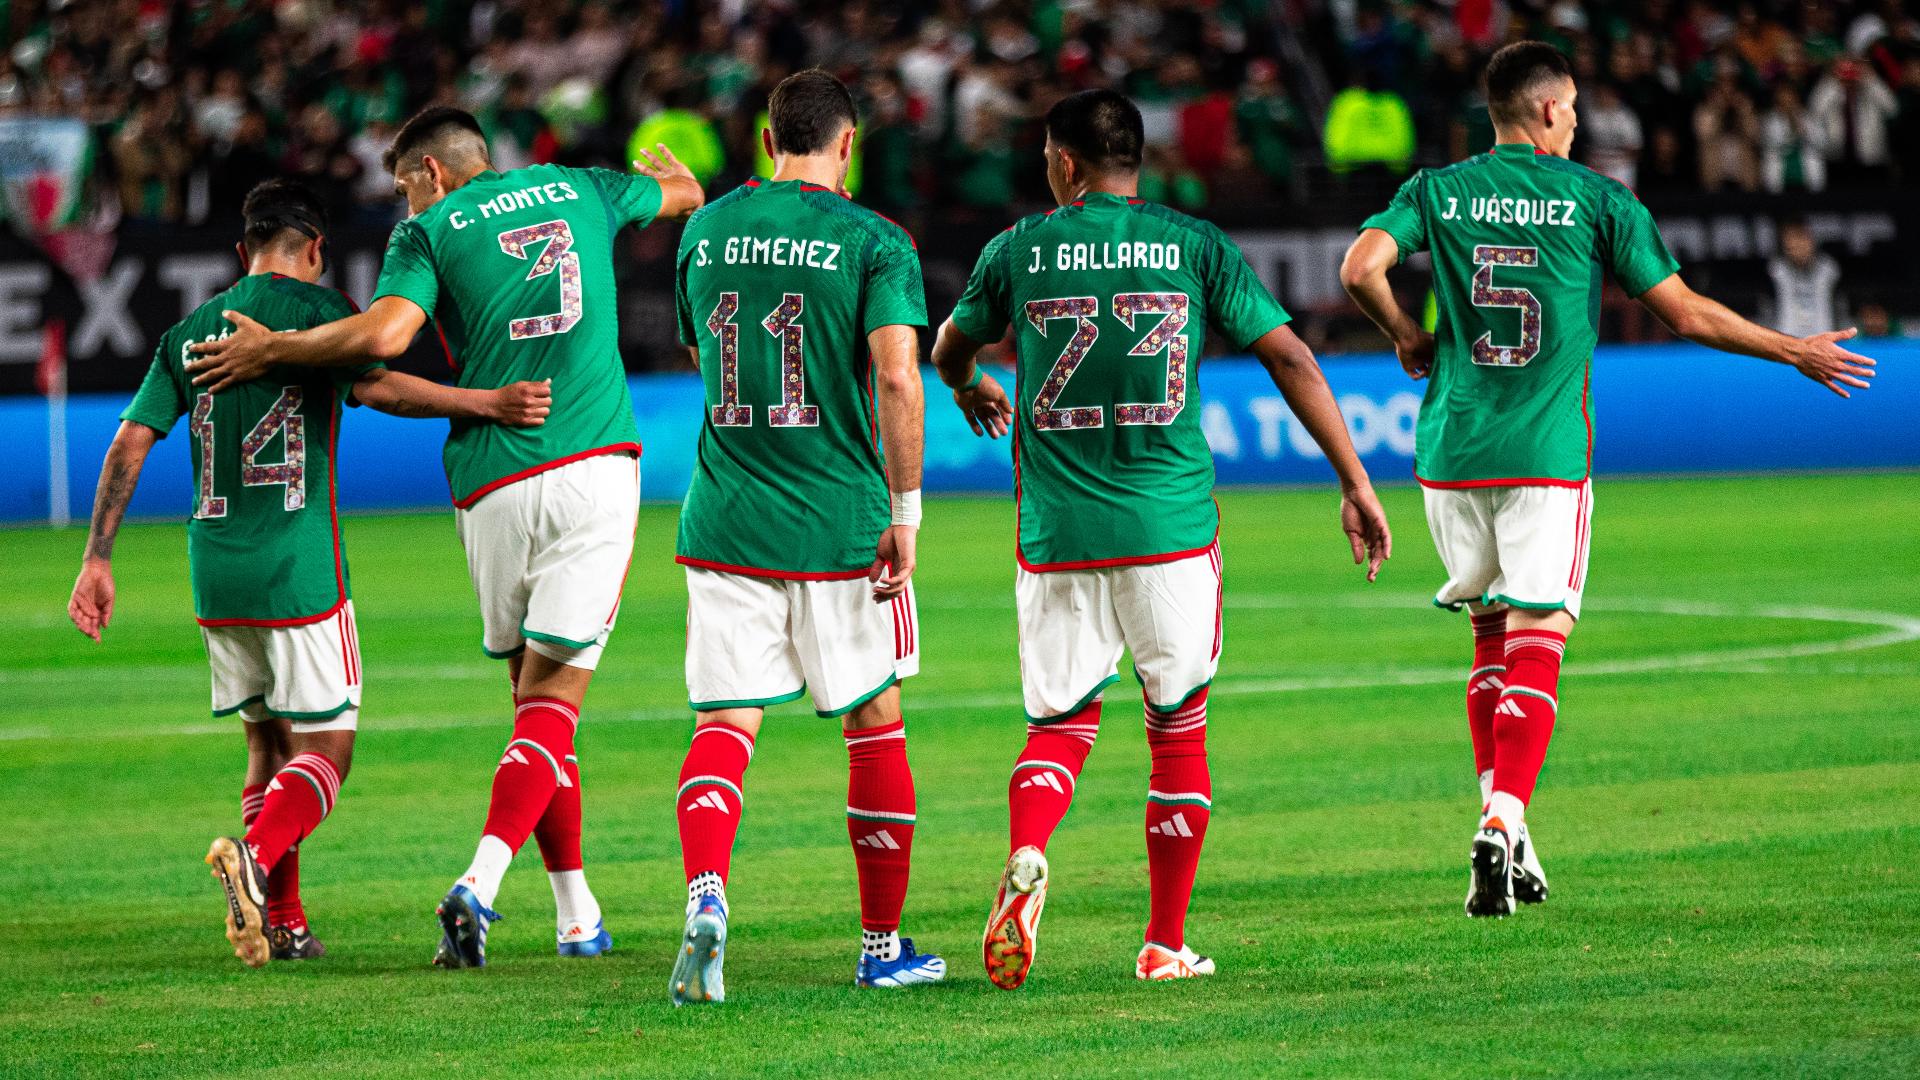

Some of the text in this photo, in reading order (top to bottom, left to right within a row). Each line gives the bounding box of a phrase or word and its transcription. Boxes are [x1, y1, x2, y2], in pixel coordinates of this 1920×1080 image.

[449, 182, 579, 230] C. MONTES
[696, 236, 841, 271] S. GIMENEZ
[1028, 242, 1180, 274] J. GALLARDO
[1441, 193, 1577, 227] J. VÁSQUEZ
[498, 219, 582, 340] 3
[1471, 244, 1542, 367] 5
[706, 292, 820, 427] 11
[1025, 292, 1189, 431] 23
[191, 385, 306, 519] 14
